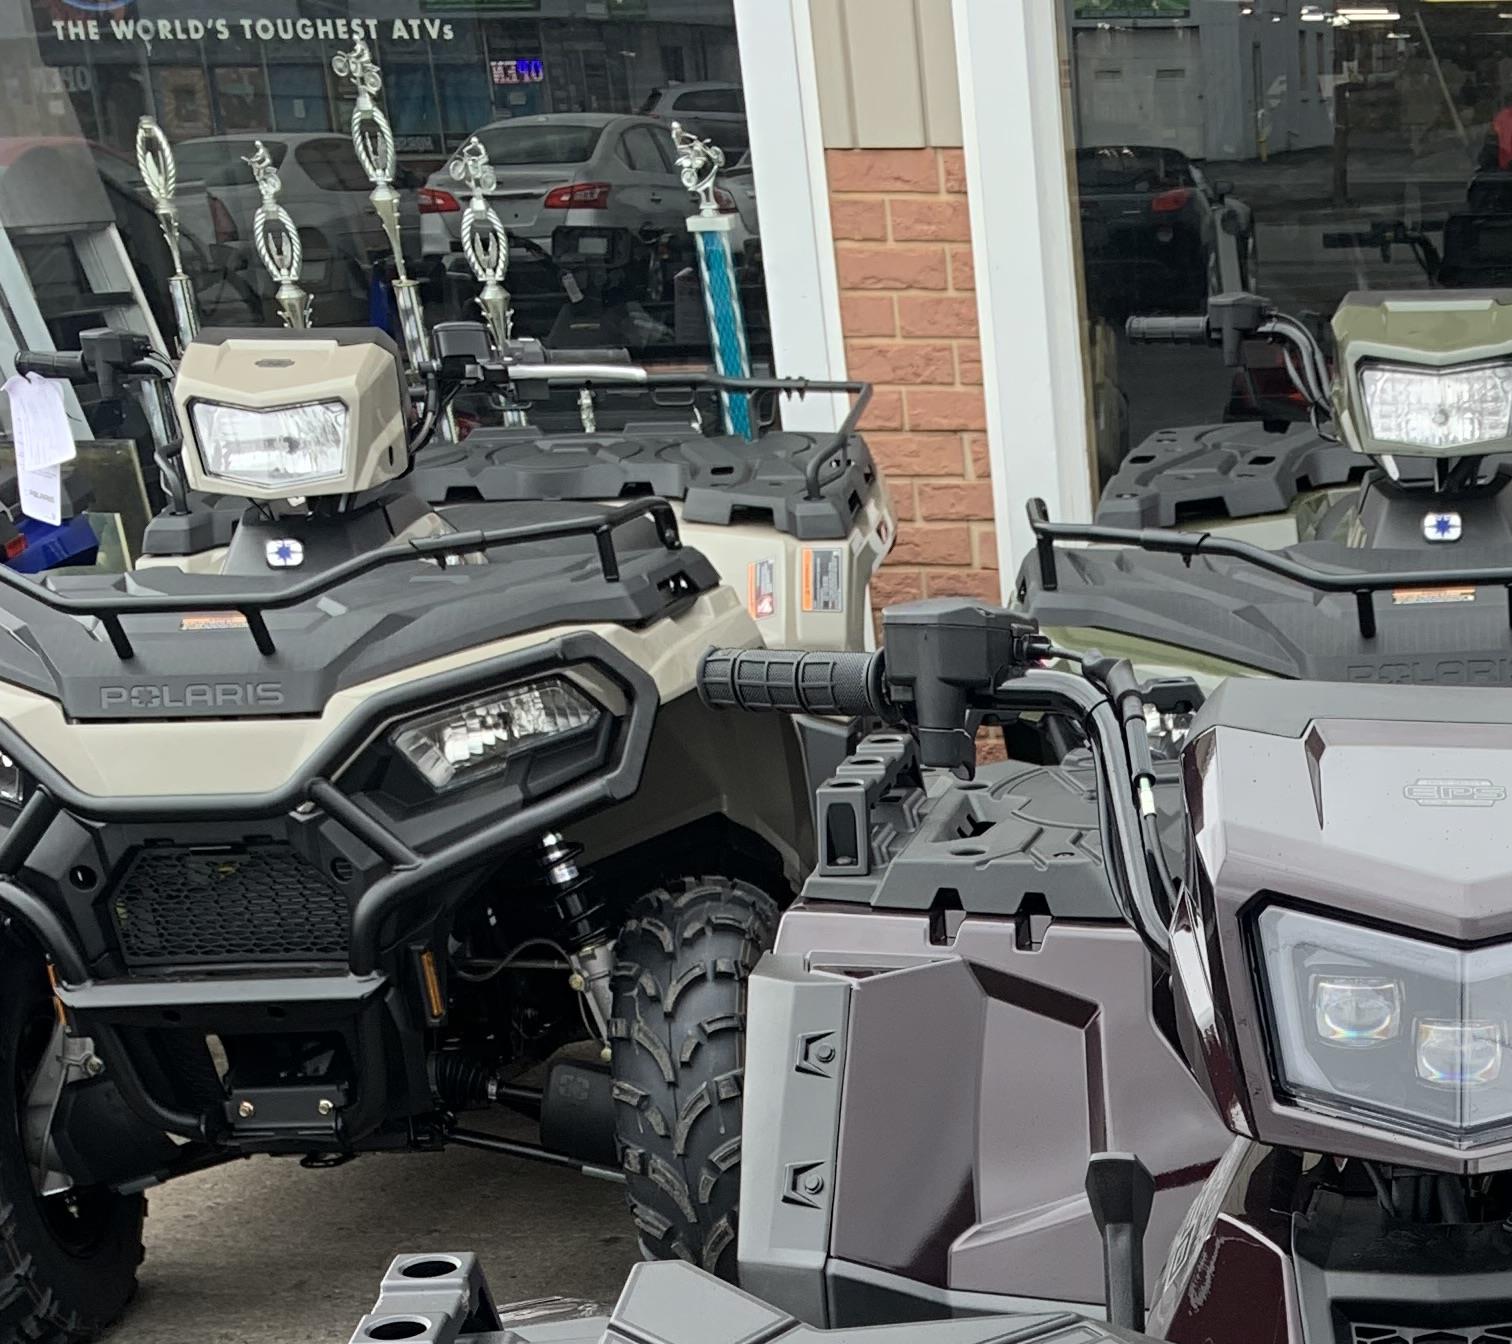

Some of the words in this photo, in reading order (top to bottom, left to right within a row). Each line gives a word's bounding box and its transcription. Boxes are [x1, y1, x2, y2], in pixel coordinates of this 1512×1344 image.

[53, 20, 98, 40] THE
[110, 19, 229, 40] WORLD'S
[240, 19, 378, 40] TOUGHEST
[392, 19, 454, 40] ATVs
[100, 682, 285, 709] POLARIS
